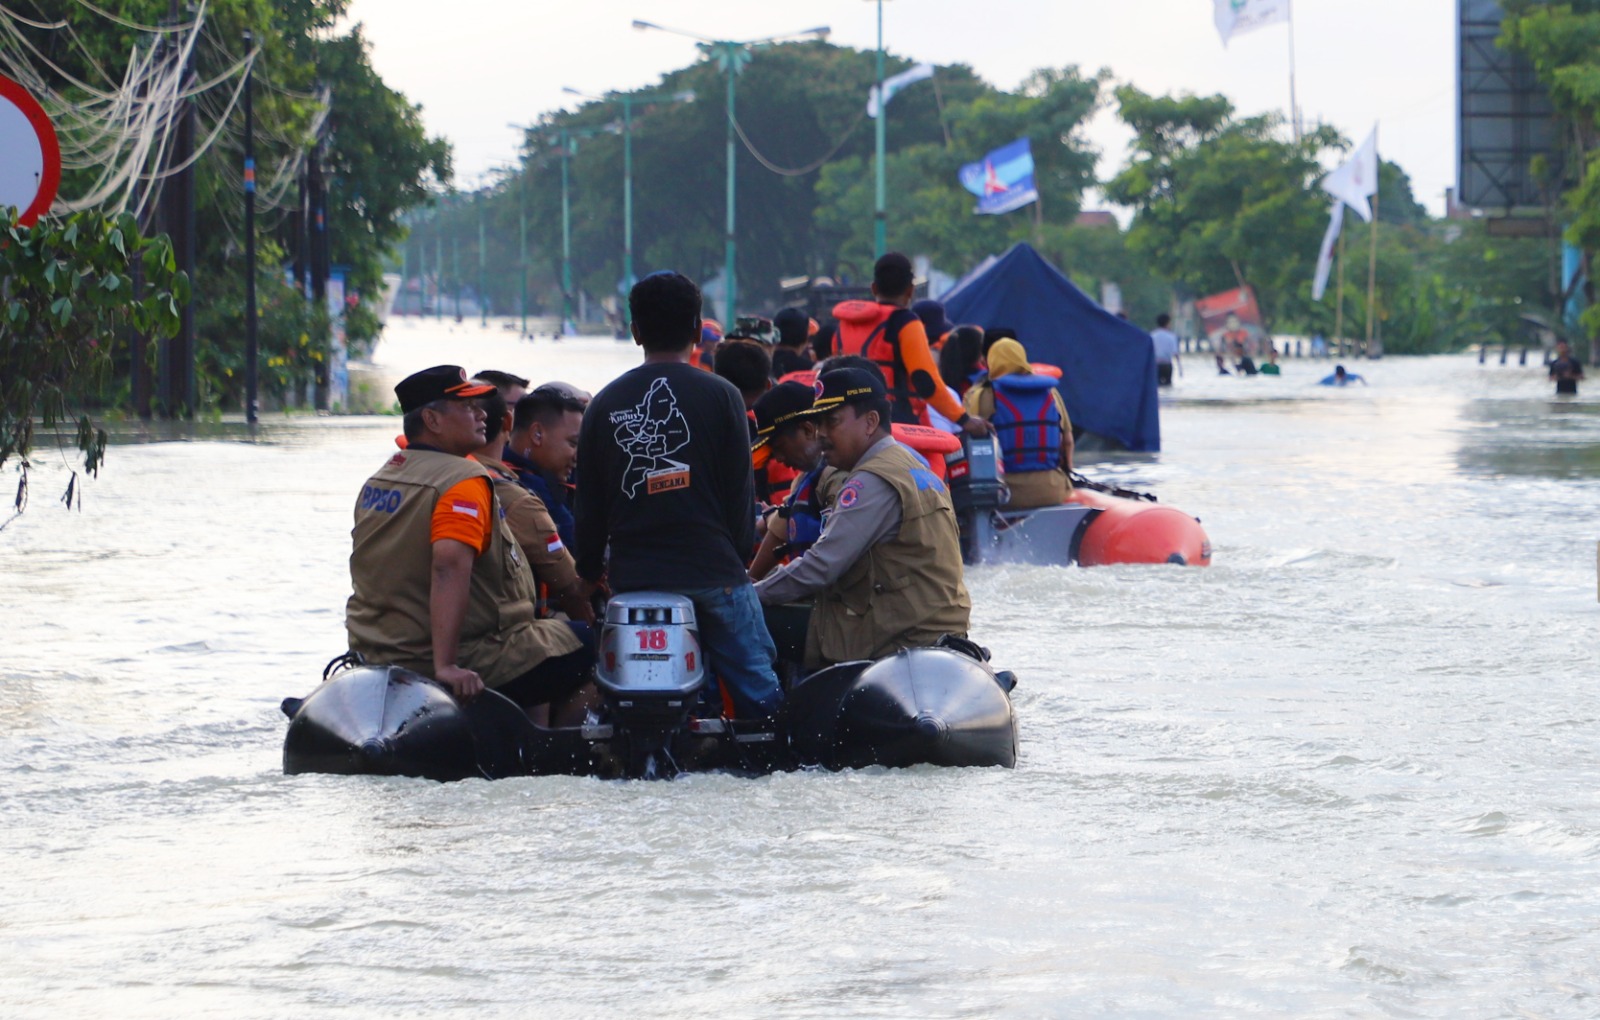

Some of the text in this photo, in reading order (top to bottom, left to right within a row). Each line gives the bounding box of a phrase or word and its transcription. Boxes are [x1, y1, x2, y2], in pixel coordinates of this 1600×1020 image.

[972, 445, 992, 456] 25
[651, 477, 686, 492] BENCANA
[635, 628, 667, 651] 18
